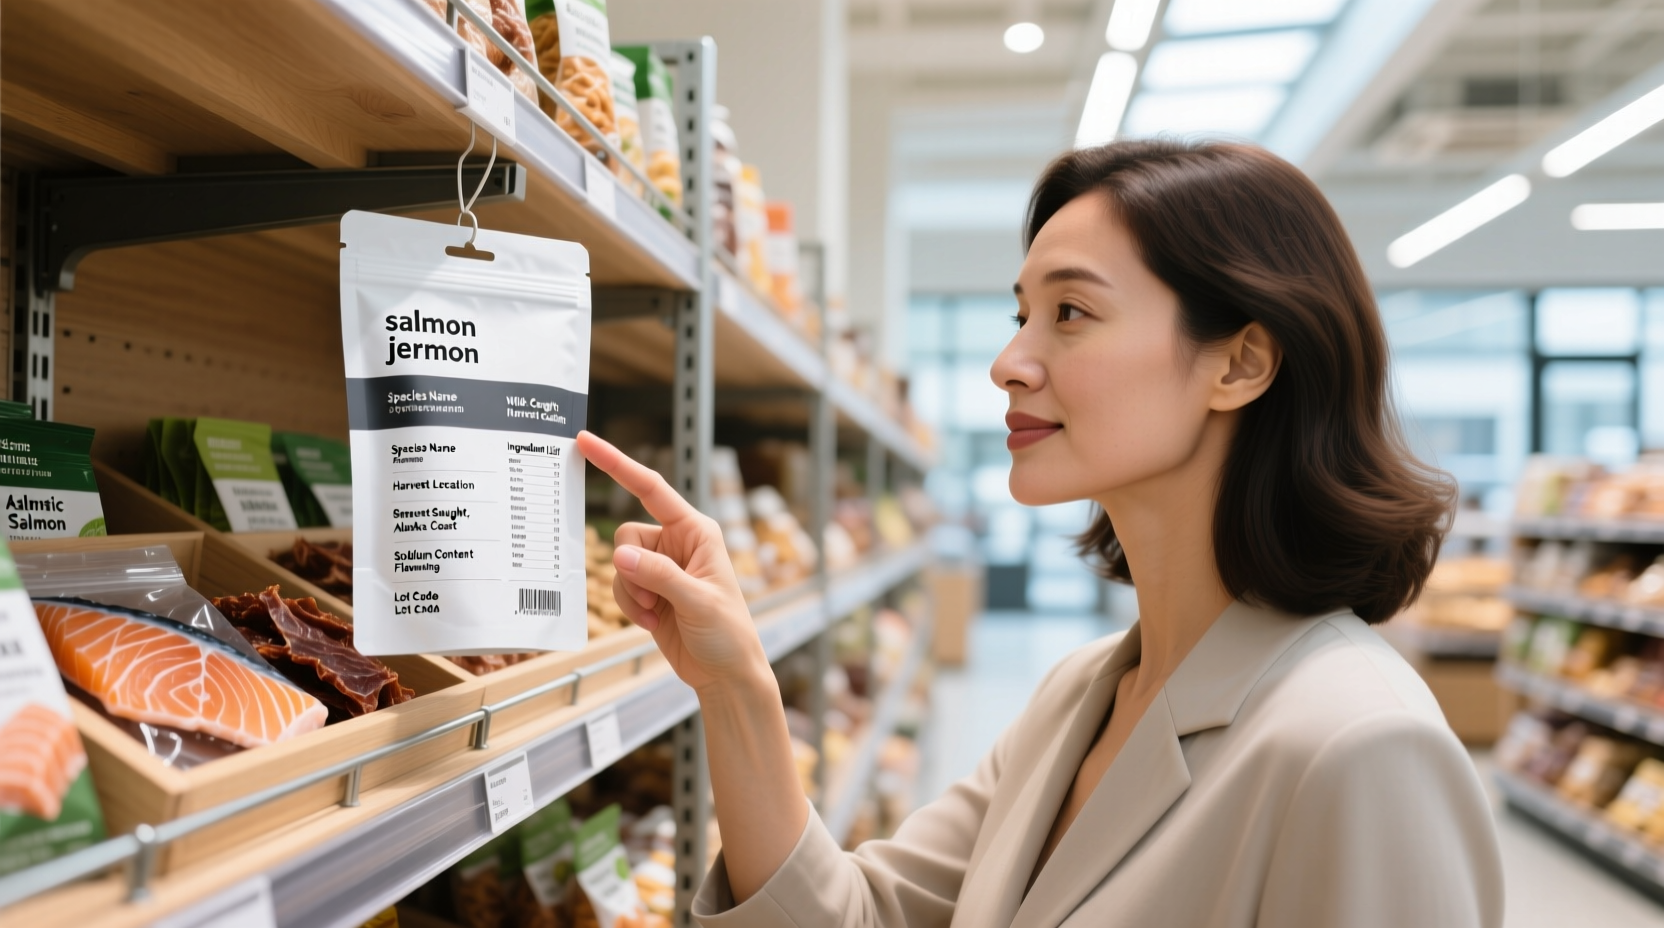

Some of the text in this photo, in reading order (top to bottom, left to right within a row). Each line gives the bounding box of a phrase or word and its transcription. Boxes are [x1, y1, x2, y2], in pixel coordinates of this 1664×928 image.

[385, 309, 476, 337] salmon
[385, 336, 479, 366] jermon
[8, 513, 66, 530] Salmon
